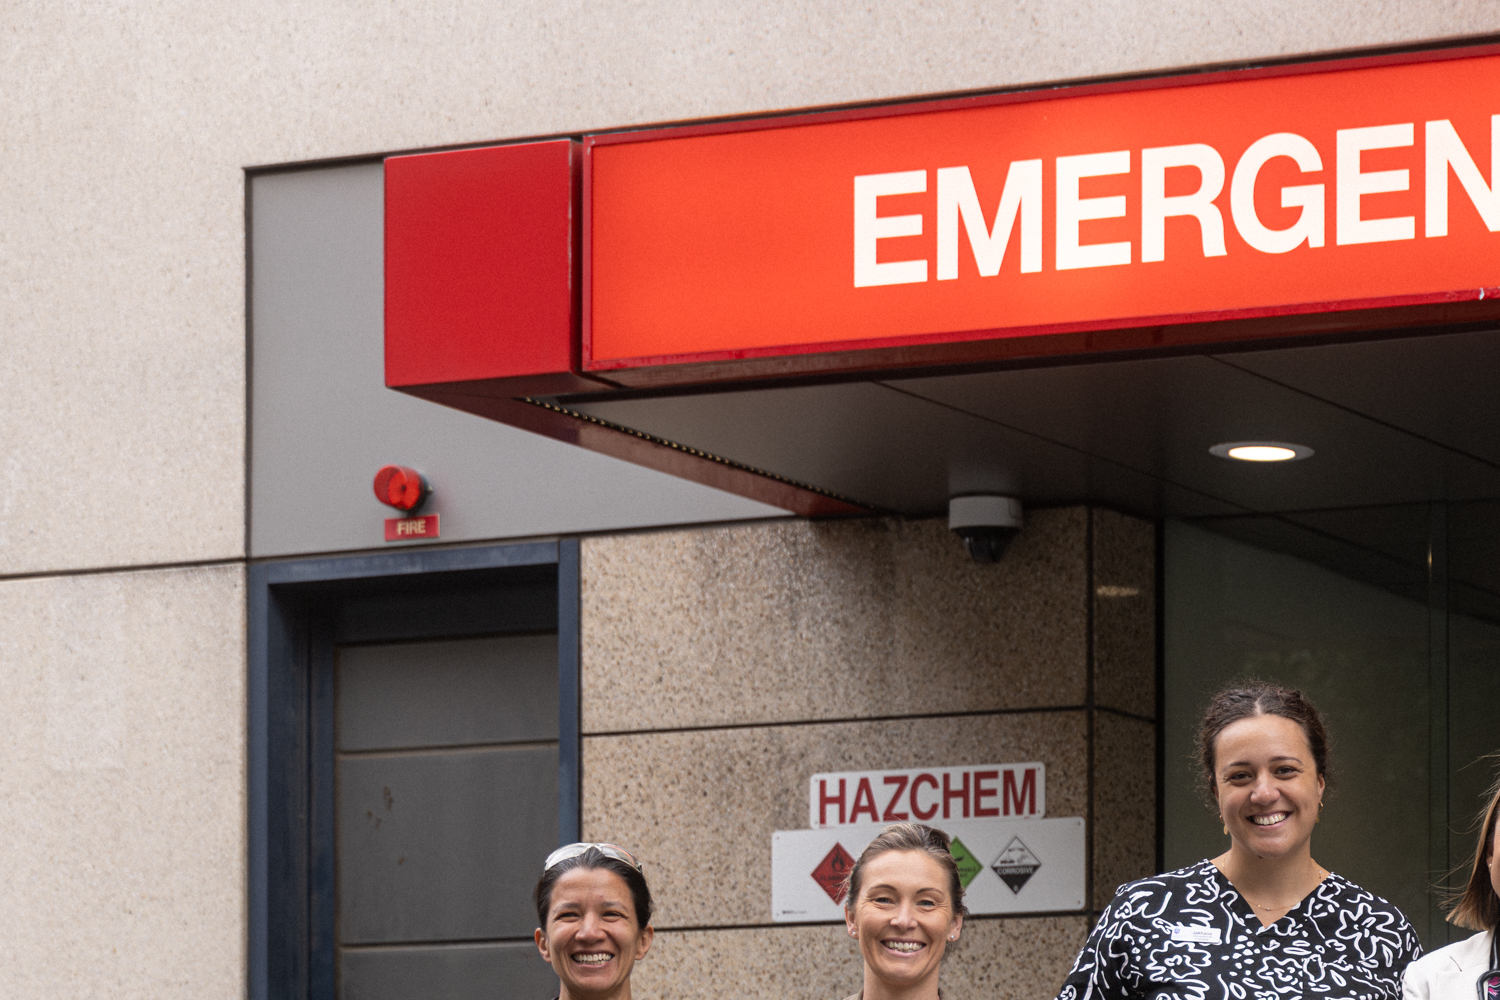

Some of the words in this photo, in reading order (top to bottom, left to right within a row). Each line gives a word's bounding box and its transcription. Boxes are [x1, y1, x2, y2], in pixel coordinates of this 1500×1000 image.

[397, 518, 427, 536] FIRE
[819, 768, 1037, 825] HAZCHEM
[997, 866, 1034, 876] CORROSIVE
